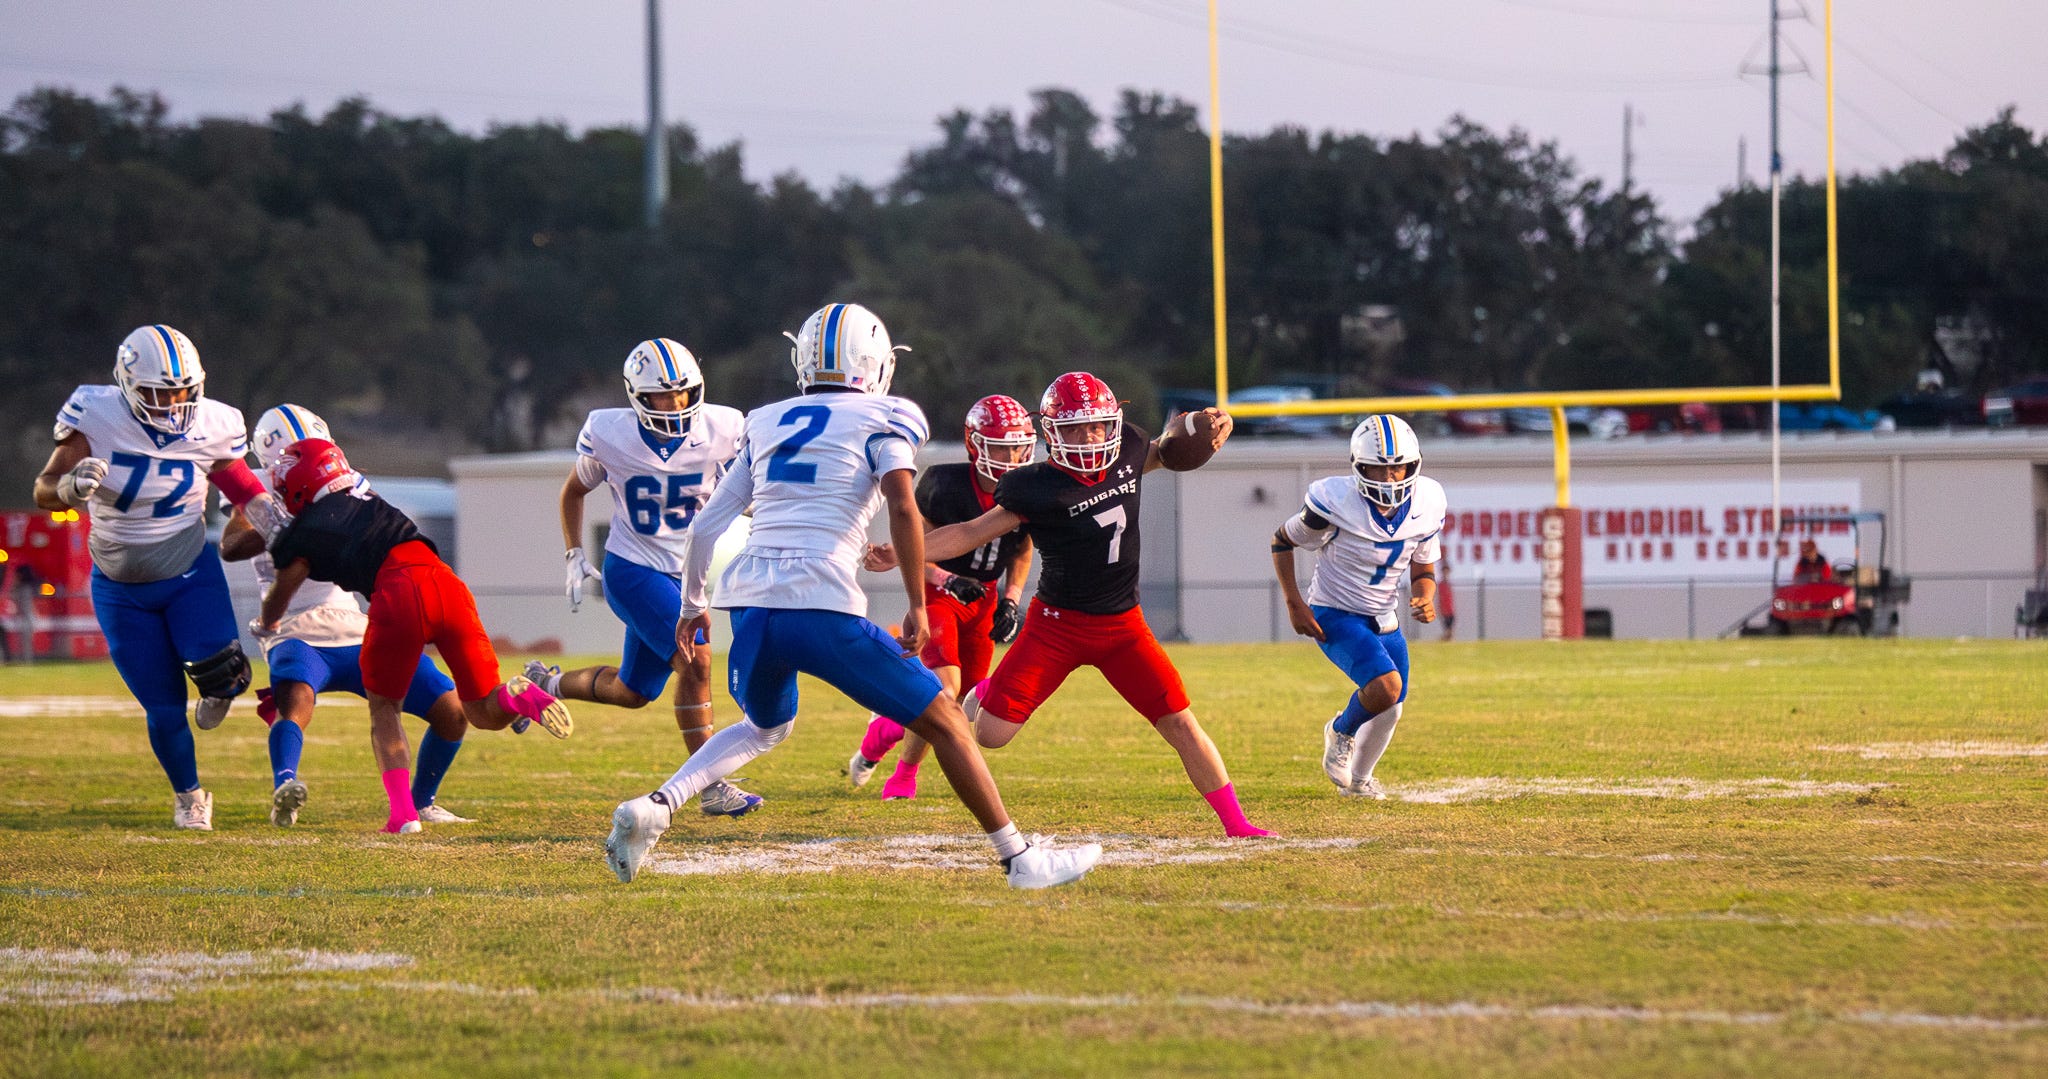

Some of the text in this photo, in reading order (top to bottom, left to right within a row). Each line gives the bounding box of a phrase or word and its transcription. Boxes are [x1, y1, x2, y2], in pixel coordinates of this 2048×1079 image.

[766, 405, 832, 485] 2
[111, 452, 194, 518] 72
[625, 472, 704, 536] 65
[1067, 479, 1136, 518] COUGARS
[1092, 504, 1127, 565] 7
[1587, 510, 1712, 537] EMORIAL
[1696, 540, 1790, 560] SCHOO
[1369, 541, 1404, 585] 7
[1542, 514, 1564, 640] COUGAR
